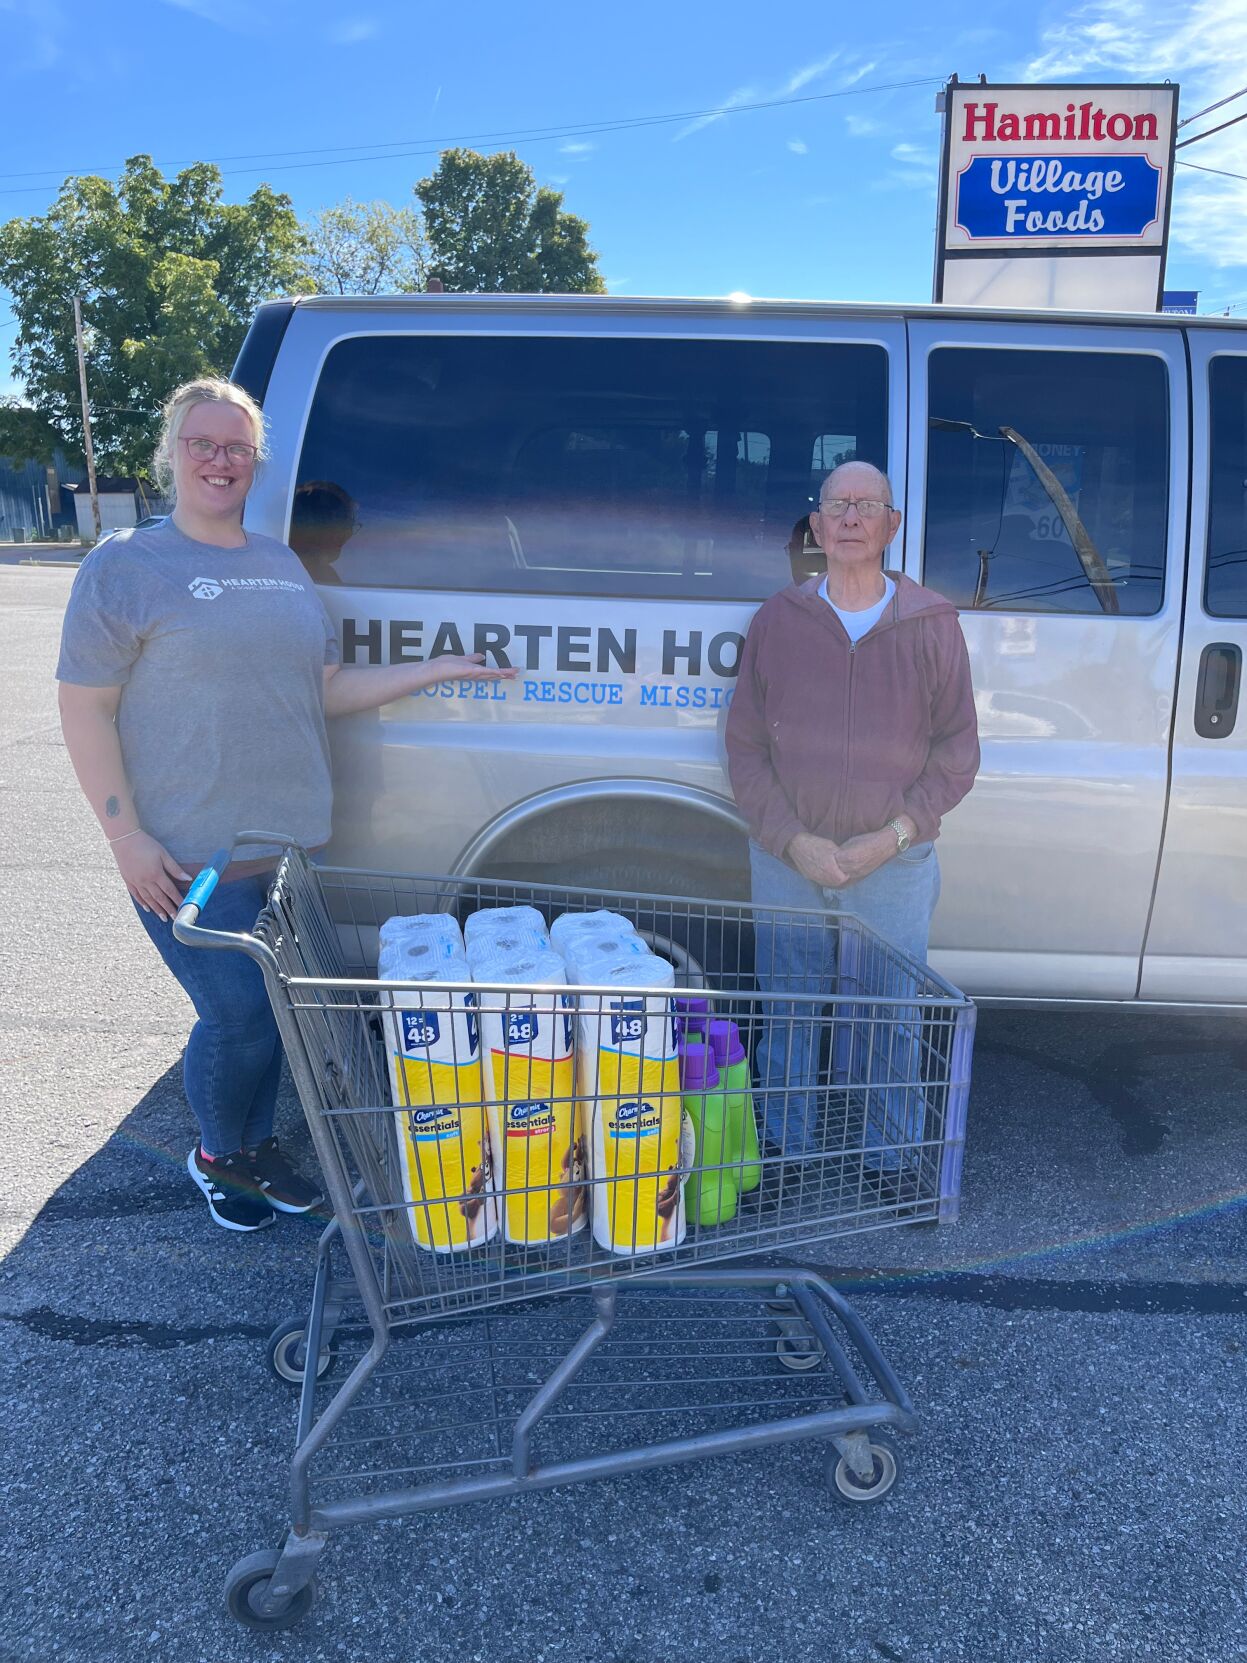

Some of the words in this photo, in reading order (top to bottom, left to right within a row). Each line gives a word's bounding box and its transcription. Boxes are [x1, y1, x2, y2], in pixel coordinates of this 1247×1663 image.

[962, 102, 1159, 142] Hamilton
[990, 160, 1125, 200] Village
[1004, 200, 1105, 233] Foods
[221, 578, 277, 586] HEARTEN
[342, 619, 637, 675] HEARTEN
[662, 629, 746, 678] HO
[408, 678, 507, 701] OSPEL
[523, 681, 624, 706] RESCUE
[407, 1026, 436, 1043] 48
[508, 1023, 534, 1040] 48
[614, 1019, 642, 1036] 48
[416, 1109, 444, 1122] Charin
[513, 1103, 541, 1117] Chamin
[619, 1104, 647, 1117] Charmn
